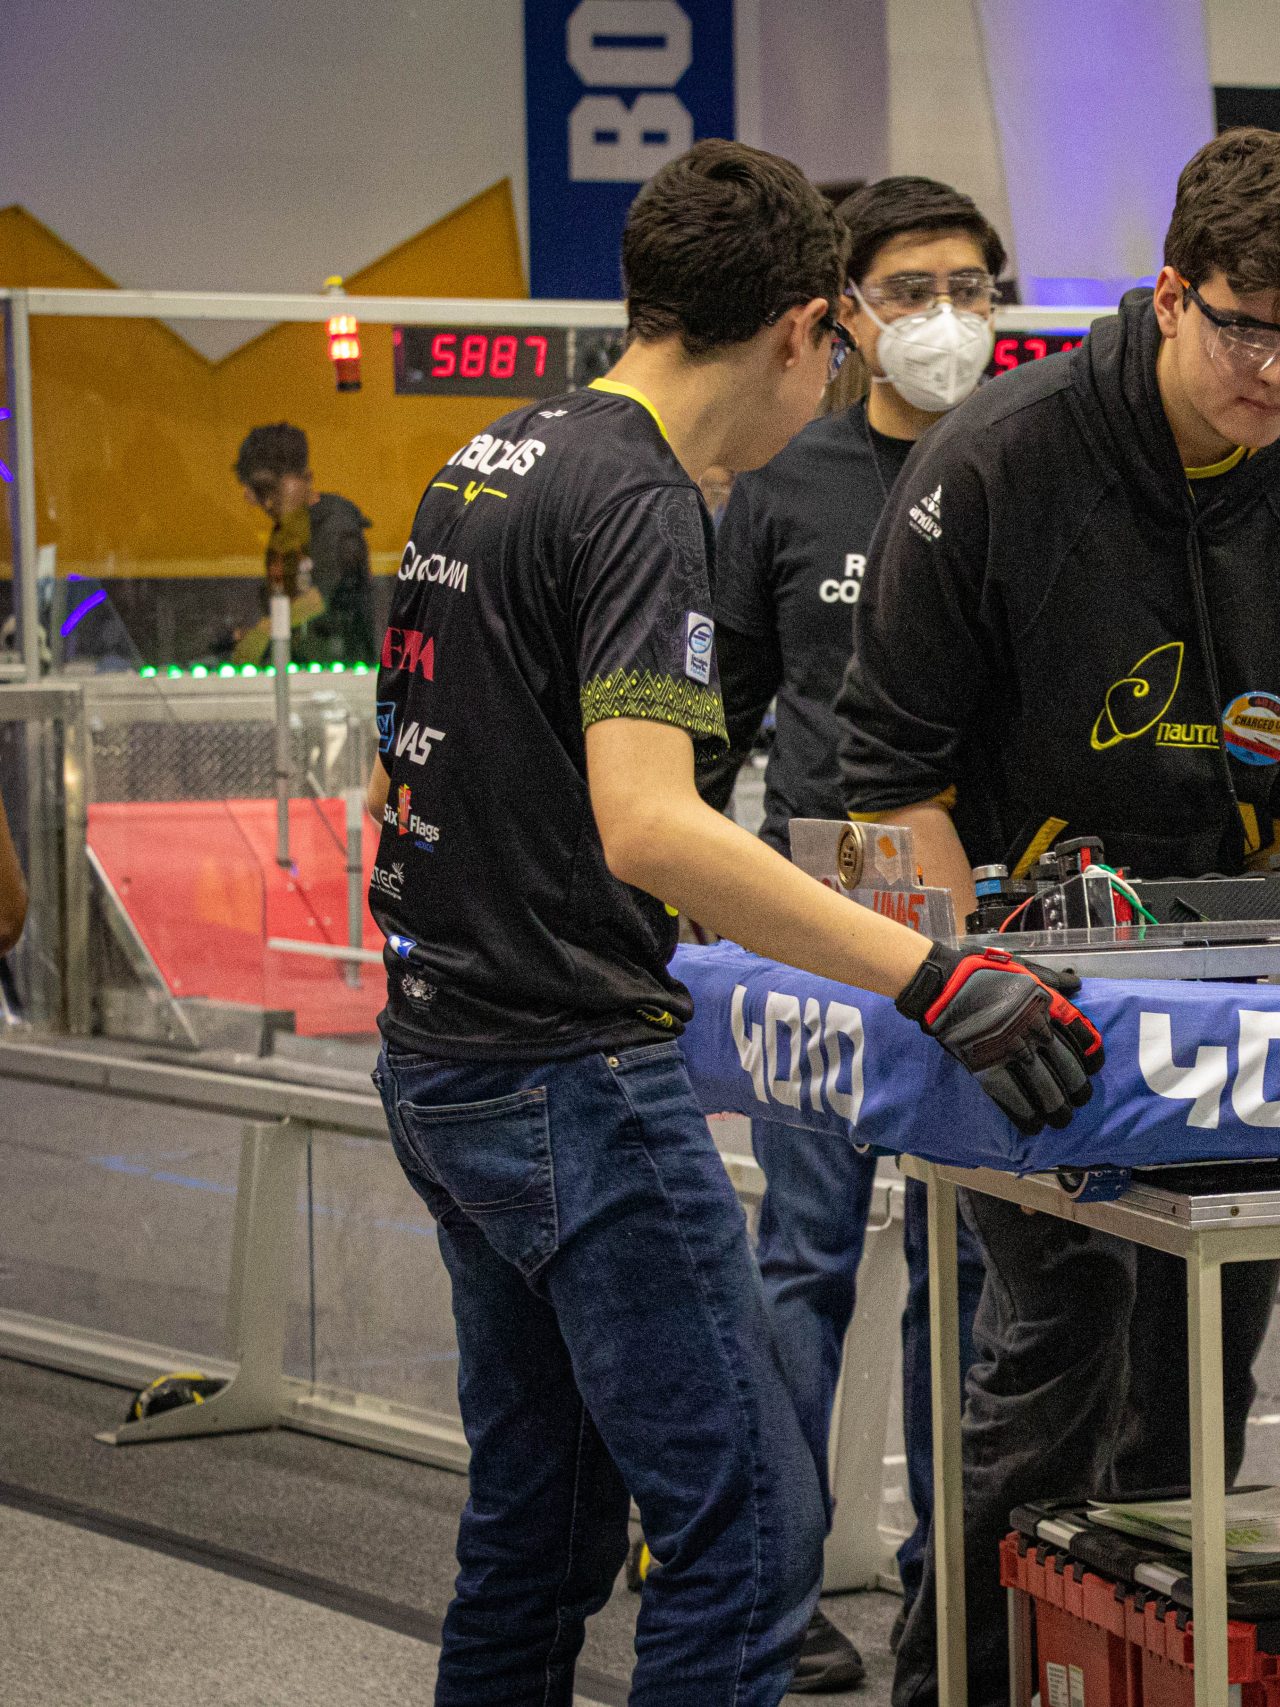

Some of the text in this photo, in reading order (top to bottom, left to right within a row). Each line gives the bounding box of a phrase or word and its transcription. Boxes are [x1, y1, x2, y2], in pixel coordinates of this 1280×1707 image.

[431, 334, 549, 378] 5887
[819, 579, 861, 604] CO
[1234, 715, 1275, 731] CHARGED
[383, 804, 440, 843] Six Flags
[731, 983, 865, 1127] 4010
